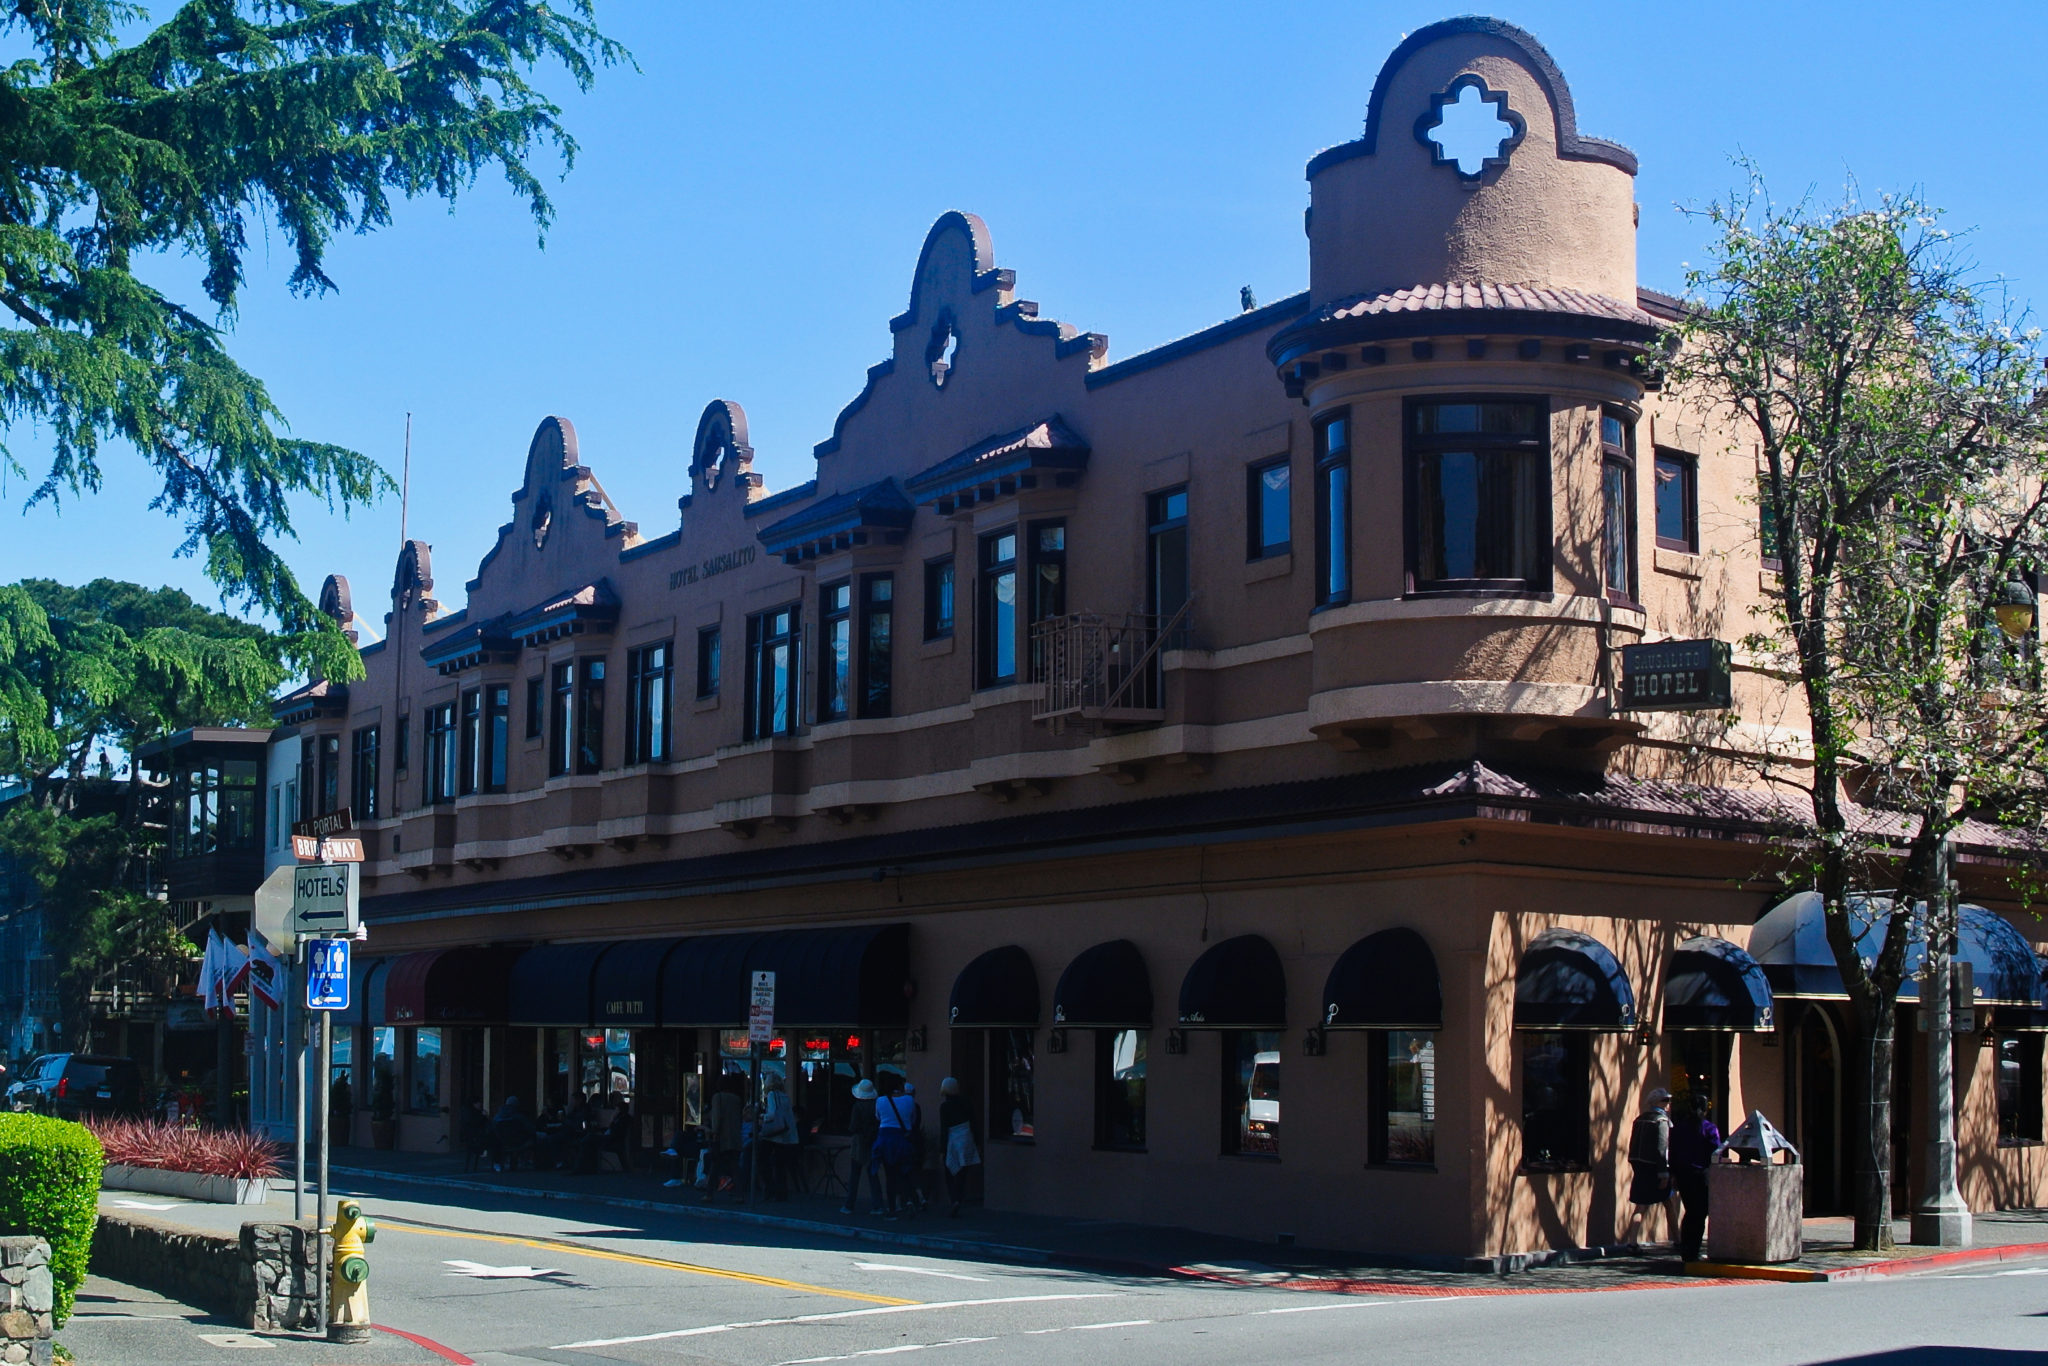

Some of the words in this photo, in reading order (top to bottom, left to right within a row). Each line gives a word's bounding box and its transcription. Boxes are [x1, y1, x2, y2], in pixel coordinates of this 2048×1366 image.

[670, 565, 699, 590] HOTEL
[702, 545, 755, 578] SAUSALITO
[1634, 652, 1699, 669] SAUSALITO
[1634, 672, 1698, 697] HOTEL
[314, 814, 344, 837] PORTAL
[297, 838, 356, 858] BRIDGEWAY
[297, 876, 345, 898] HOTELS
